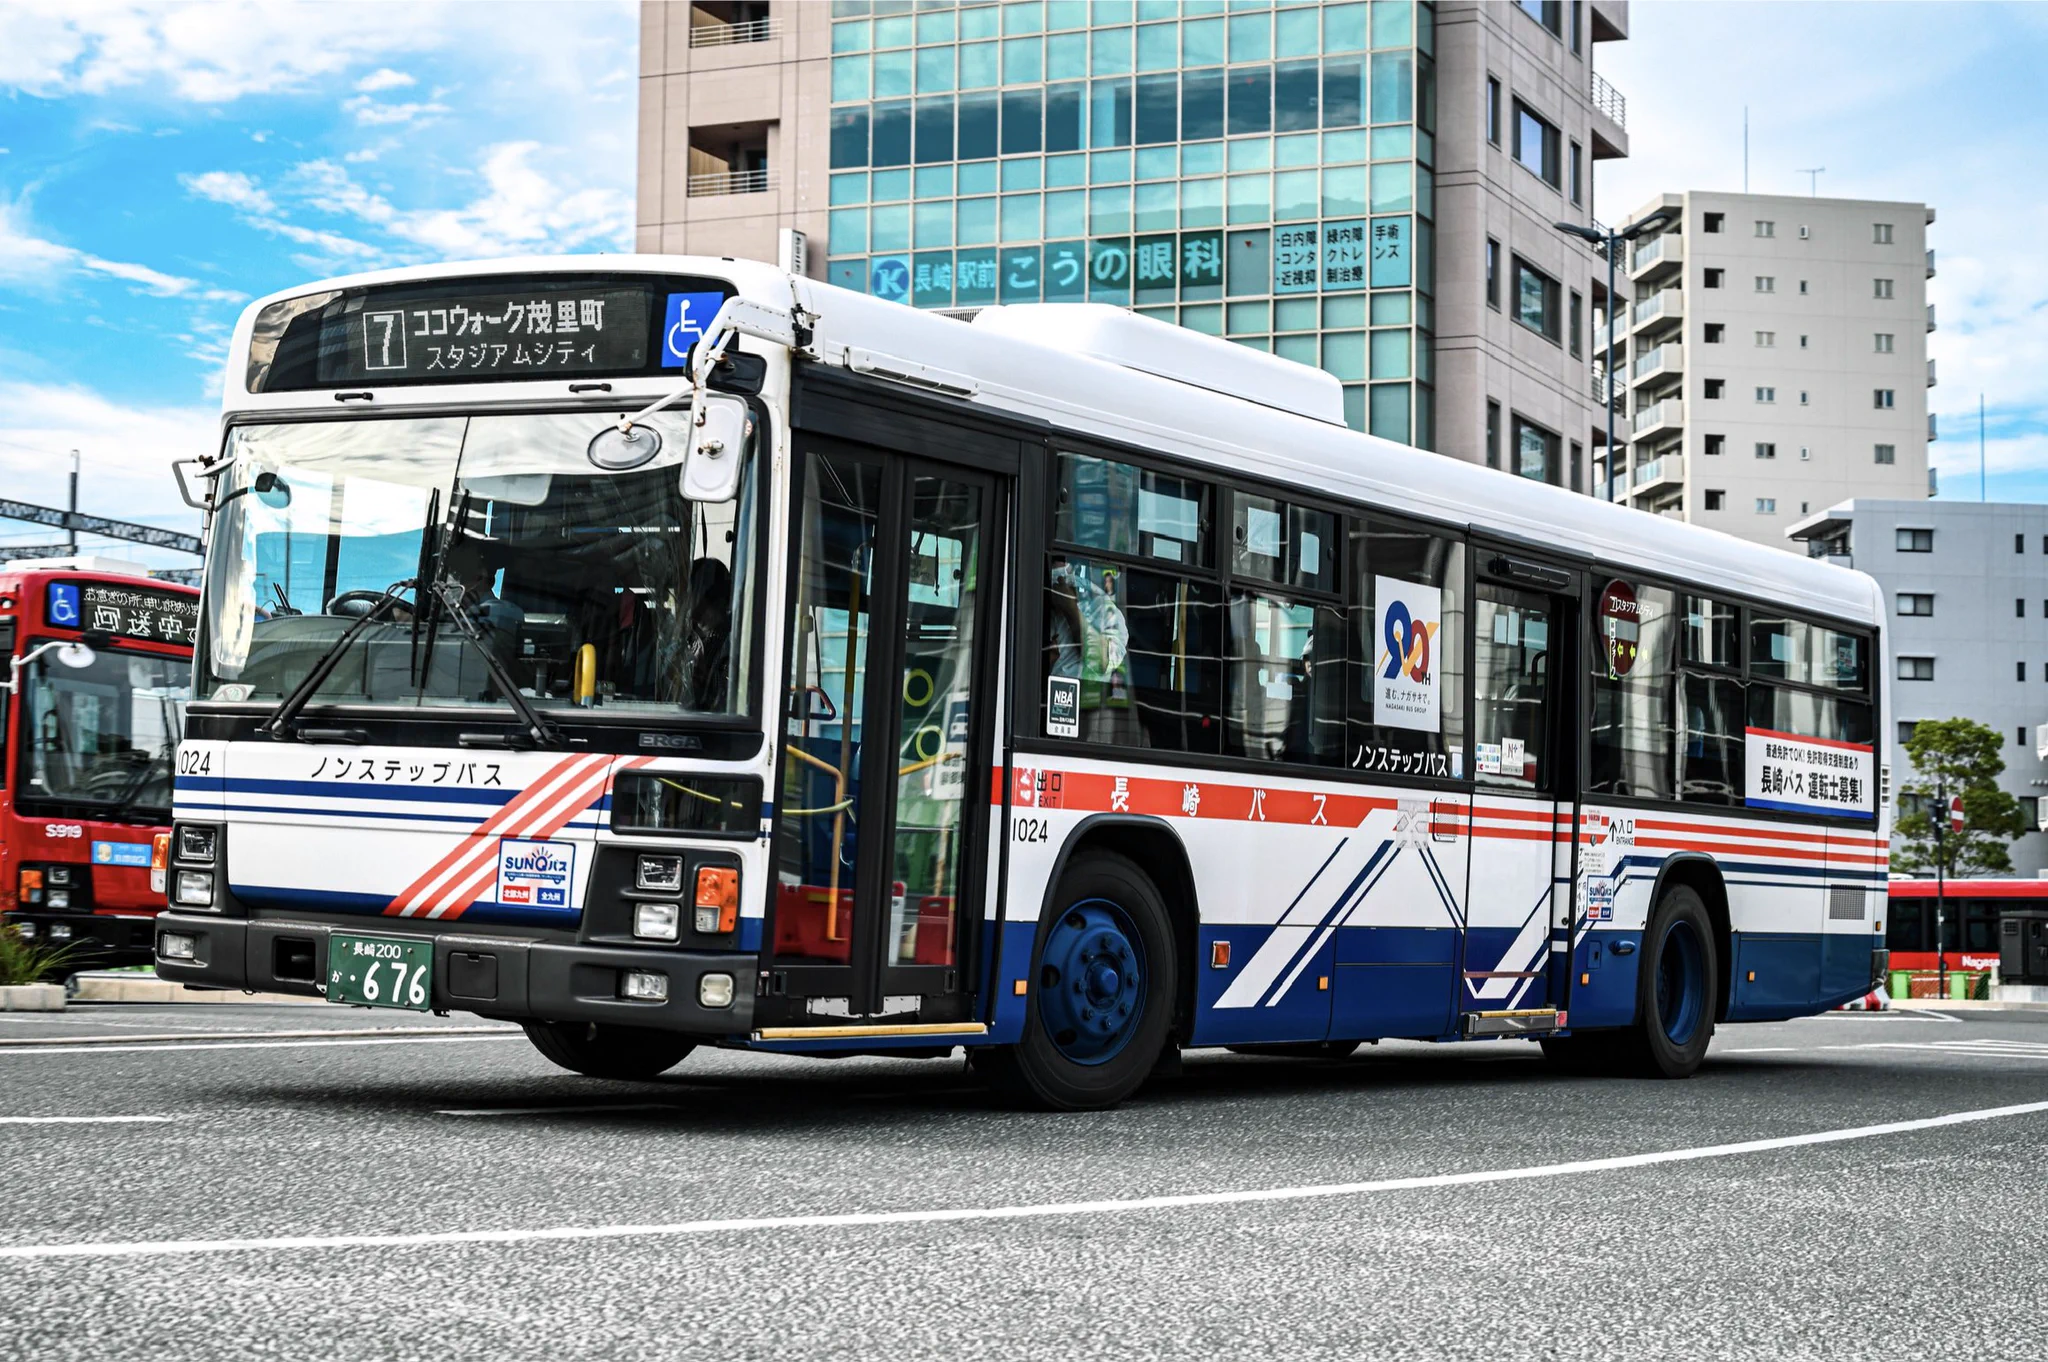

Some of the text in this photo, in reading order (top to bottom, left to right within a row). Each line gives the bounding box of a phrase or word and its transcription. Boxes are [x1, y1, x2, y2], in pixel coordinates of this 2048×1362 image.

[914, 238, 1221, 292] 長崎駅前 こうの眼科
[373, 314, 395, 366] 7
[426, 341, 596, 370] スタジアムシティ
[1054, 690, 1073, 705] NBA
[177, 750, 211, 776] 1024
[311, 757, 501, 786] ノンステップバス
[1352, 744, 1448, 777] ノンステップバス
[1036, 771, 1062, 792] 出口
[1761, 765, 1804, 796] 長崎バス
[1038, 794, 1057, 808] EXIT
[1012, 817, 1048, 843] 1024
